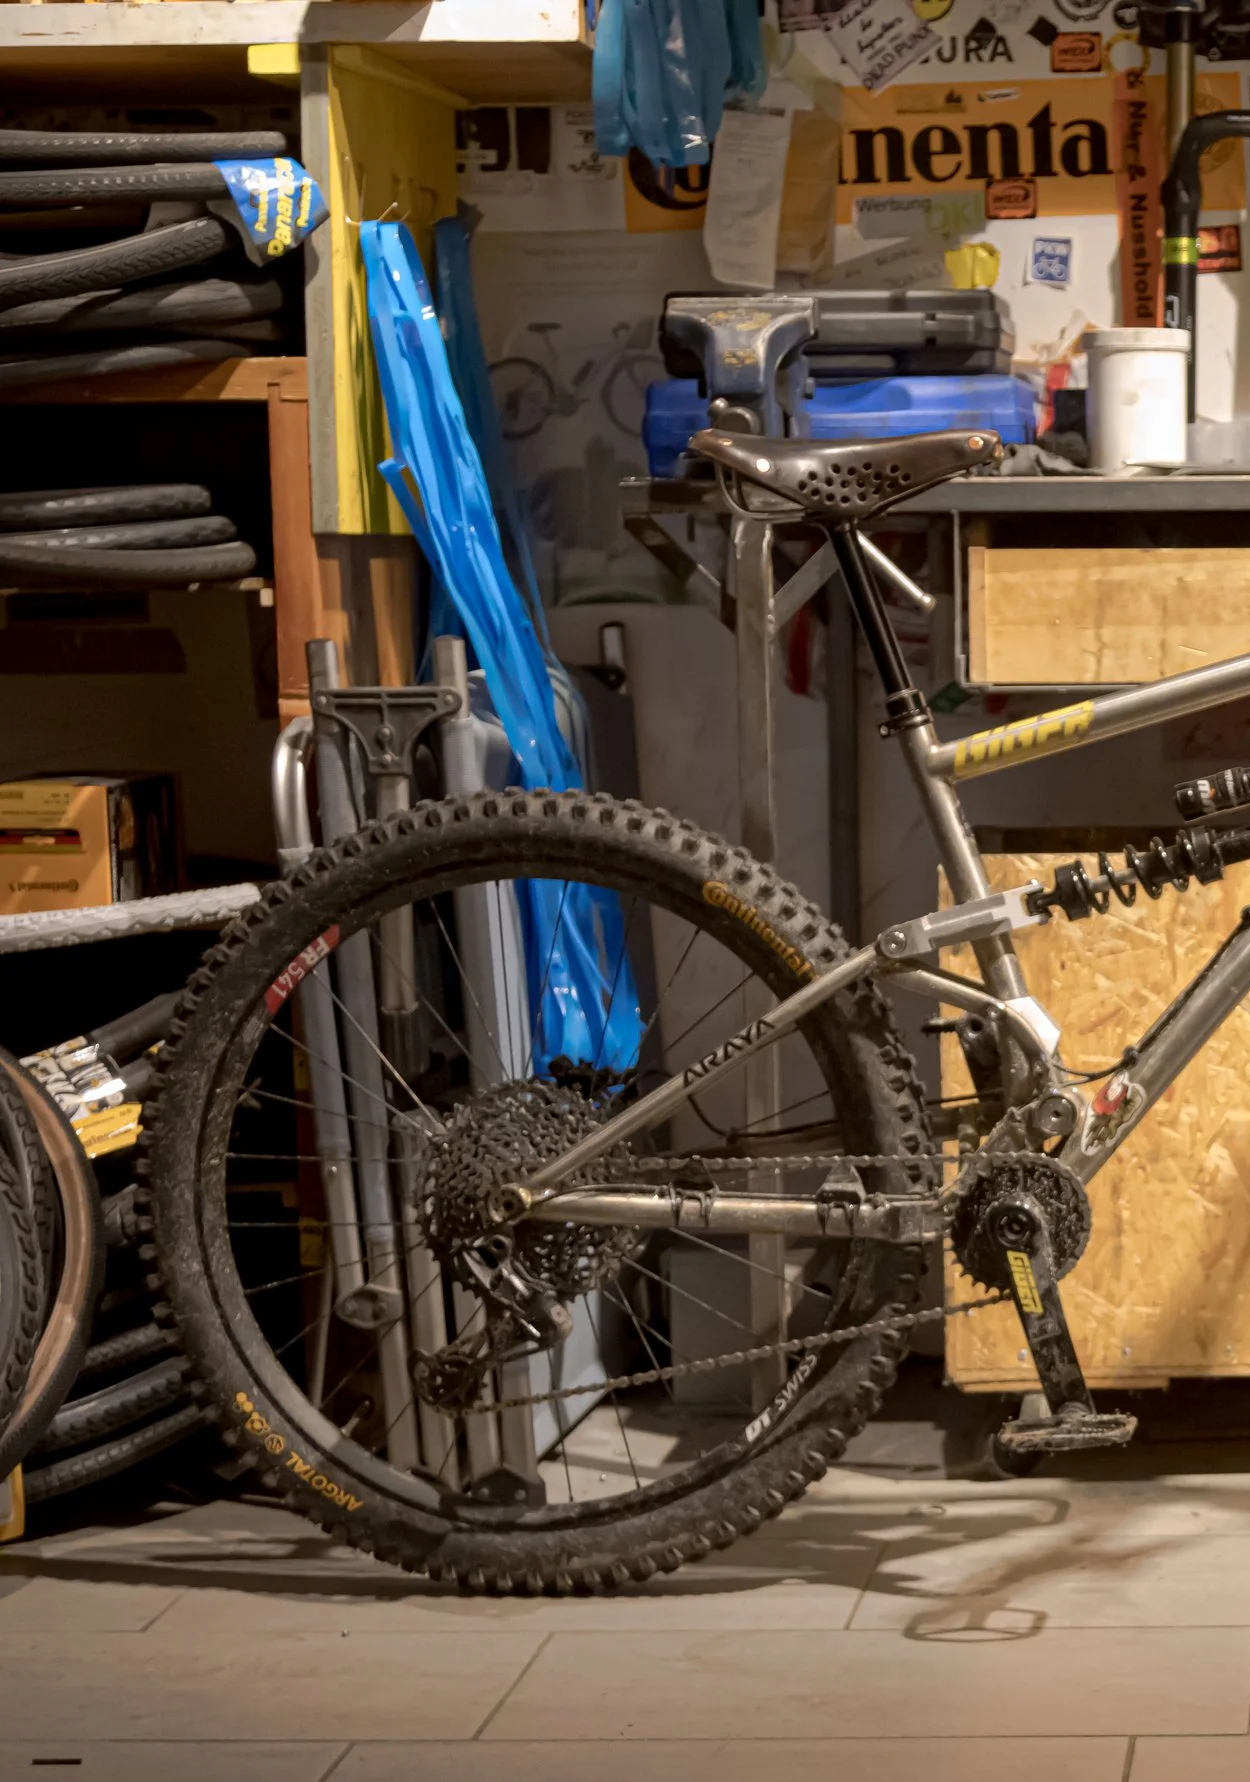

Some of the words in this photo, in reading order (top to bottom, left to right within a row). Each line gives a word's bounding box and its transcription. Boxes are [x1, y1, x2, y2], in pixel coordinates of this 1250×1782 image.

[856, 197, 932, 214] Werbung
[1129, 193, 1155, 320] Nusshold
[298, 936, 331, 966] FR
[703, 880, 812, 976] Continental
[271, 962, 306, 999] 541
[682, 1016, 776, 1089] ARAYA
[745, 1405, 774, 1442] DT
[773, 1352, 820, 1413] SWISS
[284, 1451, 365, 1512] ARGOTAL
